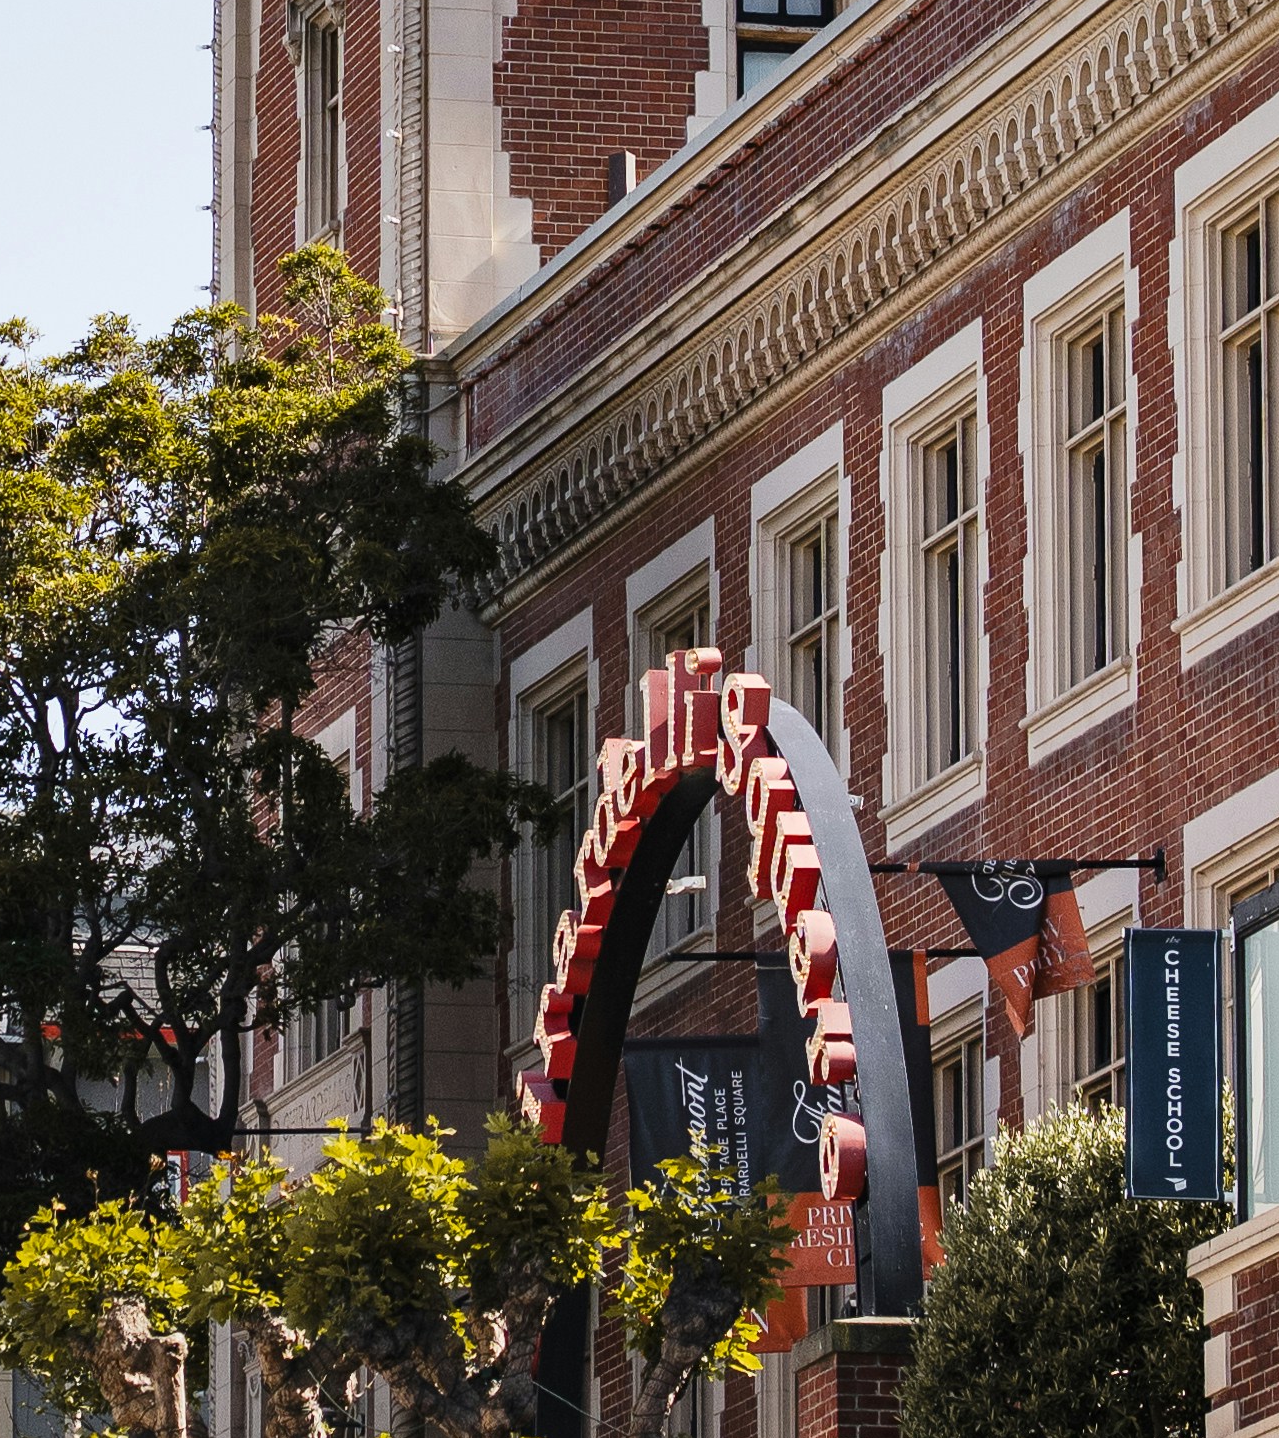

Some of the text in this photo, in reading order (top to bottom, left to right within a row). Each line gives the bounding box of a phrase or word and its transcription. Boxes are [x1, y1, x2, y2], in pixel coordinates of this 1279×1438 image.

[731, 1070, 747, 1126] SQUARE
[1164, 950, 1183, 1168] CHEESE SCHOOL
[714, 1088, 733, 1206] HERTAGE PLACE
